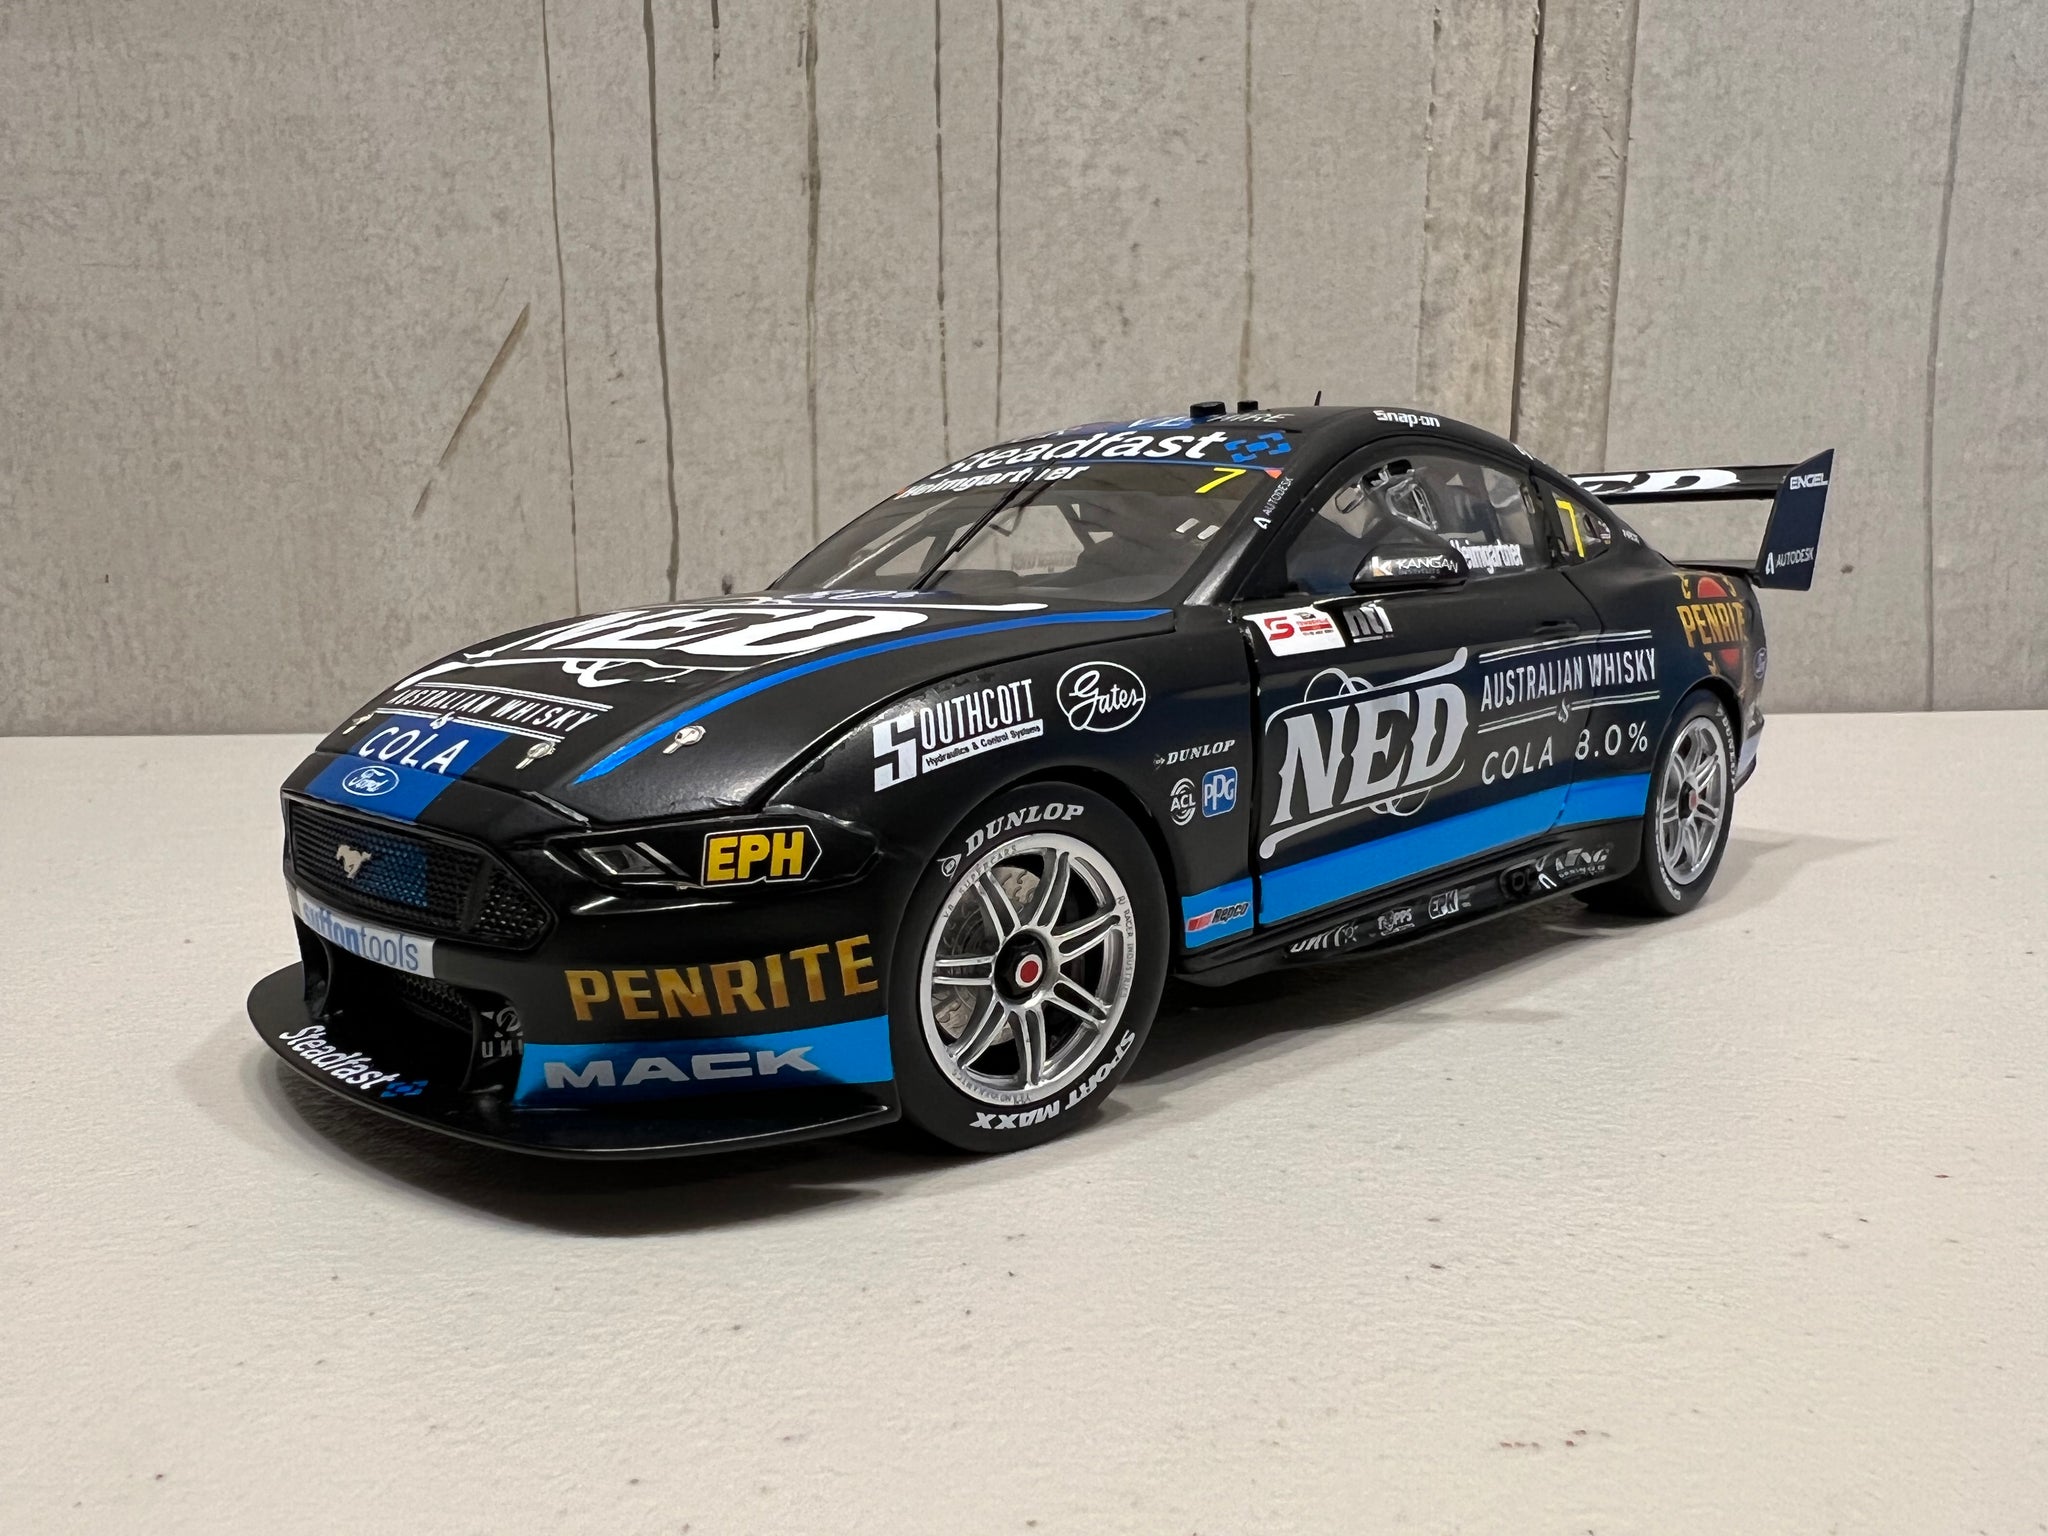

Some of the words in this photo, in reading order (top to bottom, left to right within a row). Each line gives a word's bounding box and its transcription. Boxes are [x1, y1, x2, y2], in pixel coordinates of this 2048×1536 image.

[930, 431, 1228, 479] Steadfast
[1195, 466, 1246, 494] 7
[1262, 476, 1294, 516] AUTODESK
[1789, 472, 1829, 490] ENGEL
[1556, 499, 1585, 558] 7
[1396, 555, 1458, 574] KANGAN
[1775, 547, 1815, 568] AUTODESK
[1066, 670, 1145, 731] Gates
[1481, 661, 1583, 712] AUSTRALIAN
[1588, 647, 1657, 688] WHISKY
[387, 689, 494, 714] AUSTRALIAN
[491, 699, 598, 732] WHISKY
[358, 727, 469, 774] COLA
[873, 678, 1035, 793] SOUTHCOTT
[926, 746, 970, 767] Hydraulics
[981, 733, 1009, 748] Control
[1166, 739, 1236, 765] DUNLOP
[1270, 683, 1469, 826] NED
[349, 769, 389, 792] Ford
[1482, 736, 1553, 786] COLA
[1170, 793, 1197, 812] ACL
[1204, 774, 1235, 810] PPG
[964, 802, 1085, 857] DUNLOP
[707, 831, 805, 882] EPH
[1212, 901, 1250, 923] Repco
[564, 934, 879, 1021] PENRITE
[279, 1025, 401, 1090] Steadfast
[543, 1046, 820, 1088] MACK
[1064, 1029, 1136, 1110] SPORT
[968, 1099, 1061, 1129] MAXX
